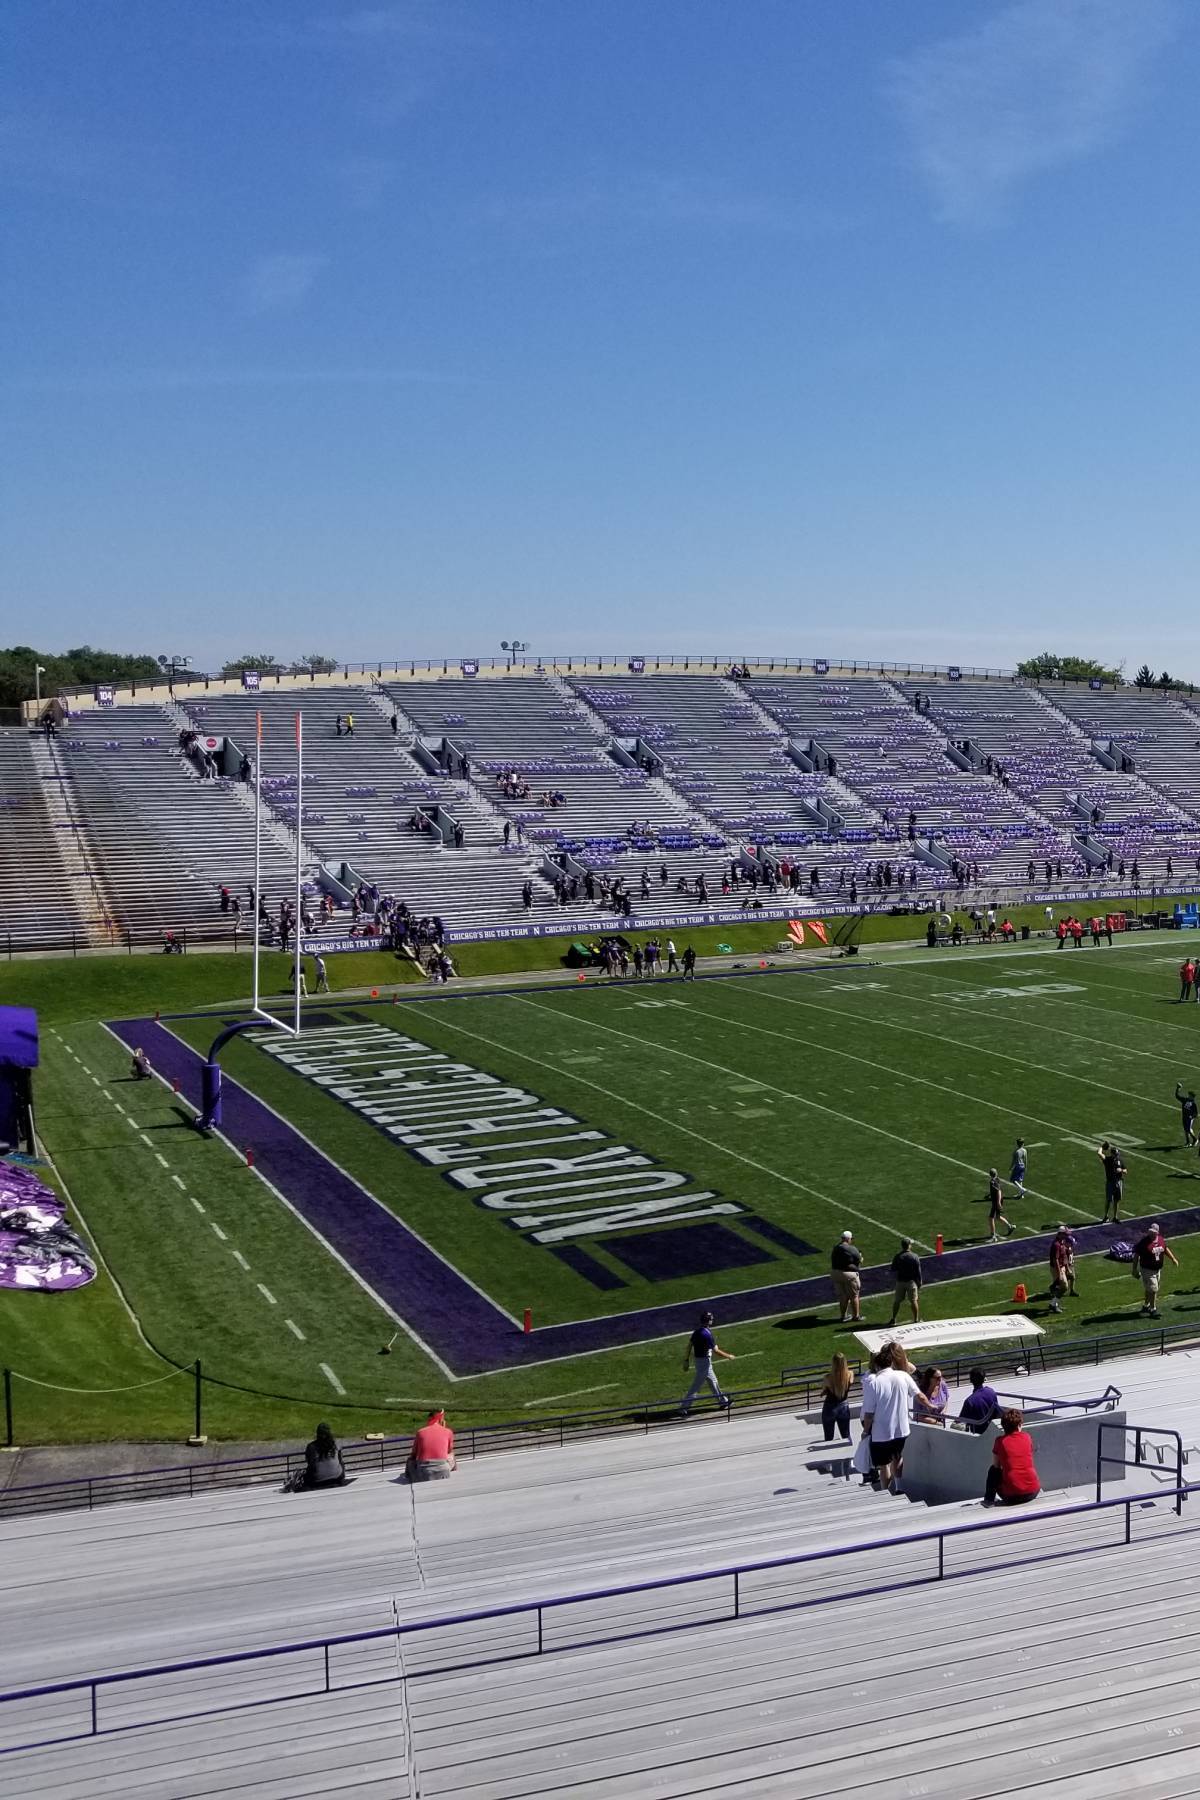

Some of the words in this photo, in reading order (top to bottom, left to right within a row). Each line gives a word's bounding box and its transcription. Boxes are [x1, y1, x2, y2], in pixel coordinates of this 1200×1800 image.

[246, 676, 258, 685] 105
[100, 691, 112, 700] 104
[718, 913, 747, 921] CHICAGO'S
[769, 910, 785, 918] TEAM
[798, 908, 825, 916] CHICAGO'S
[634, 919, 665, 927] CHICAGO'S
[450, 931, 483, 940] CHICAGO'S
[484, 930, 496, 938] BIG
[510, 928, 528, 936] TEAM
[545, 925, 577, 934] CHICAGO'S
[304, 942, 341, 952] CHICAGO'S
[342, 941, 354, 949] BIG
[355, 940, 369, 948] TEN
[633, 999, 692, 1008] 10
[240, 1023, 748, 1243] NORTHWESTERN
[1060, 1130, 1146, 1151] 10
[896, 1323, 946, 1335] SPORTS
[948, 1318, 1002, 1327] MEDICINE
